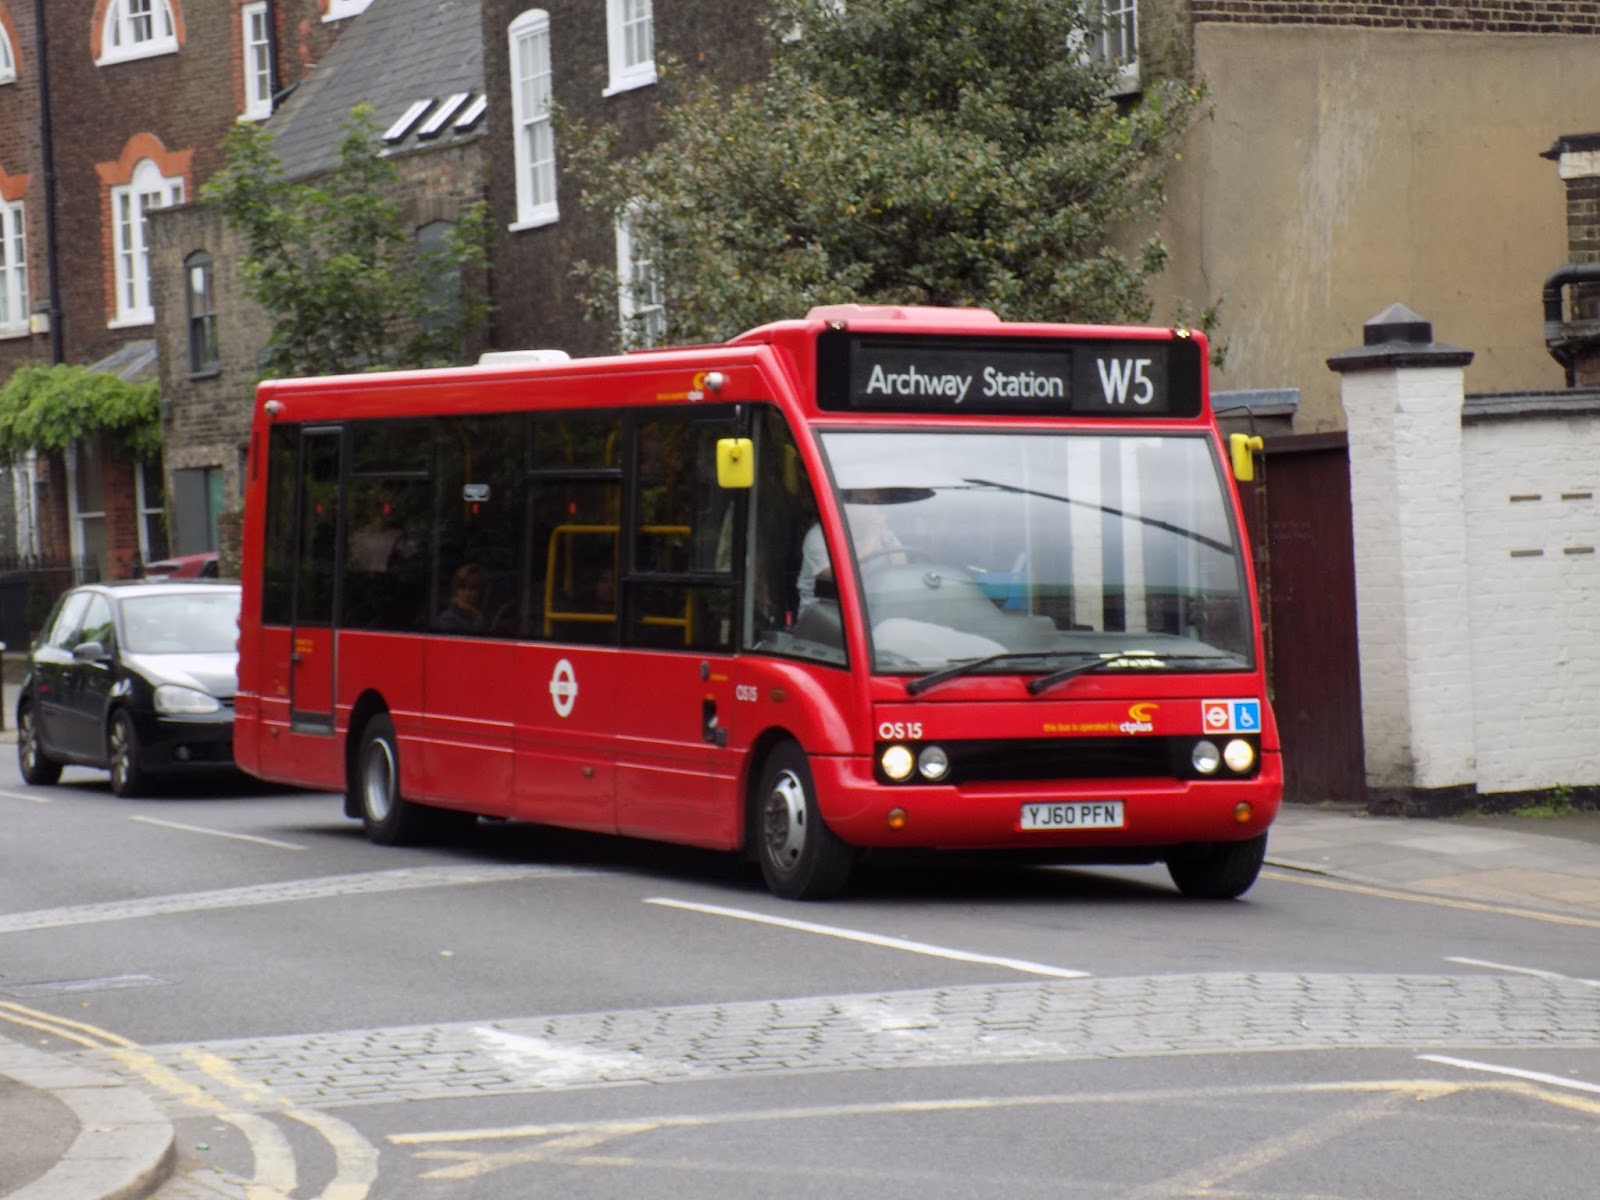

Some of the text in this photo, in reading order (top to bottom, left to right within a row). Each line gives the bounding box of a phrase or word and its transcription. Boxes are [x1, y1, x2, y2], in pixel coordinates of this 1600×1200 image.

[866, 364, 1064, 404] Archway Station
[1096, 358, 1155, 404] W5
[1029, 805, 1115, 825] YJ60 PFN
